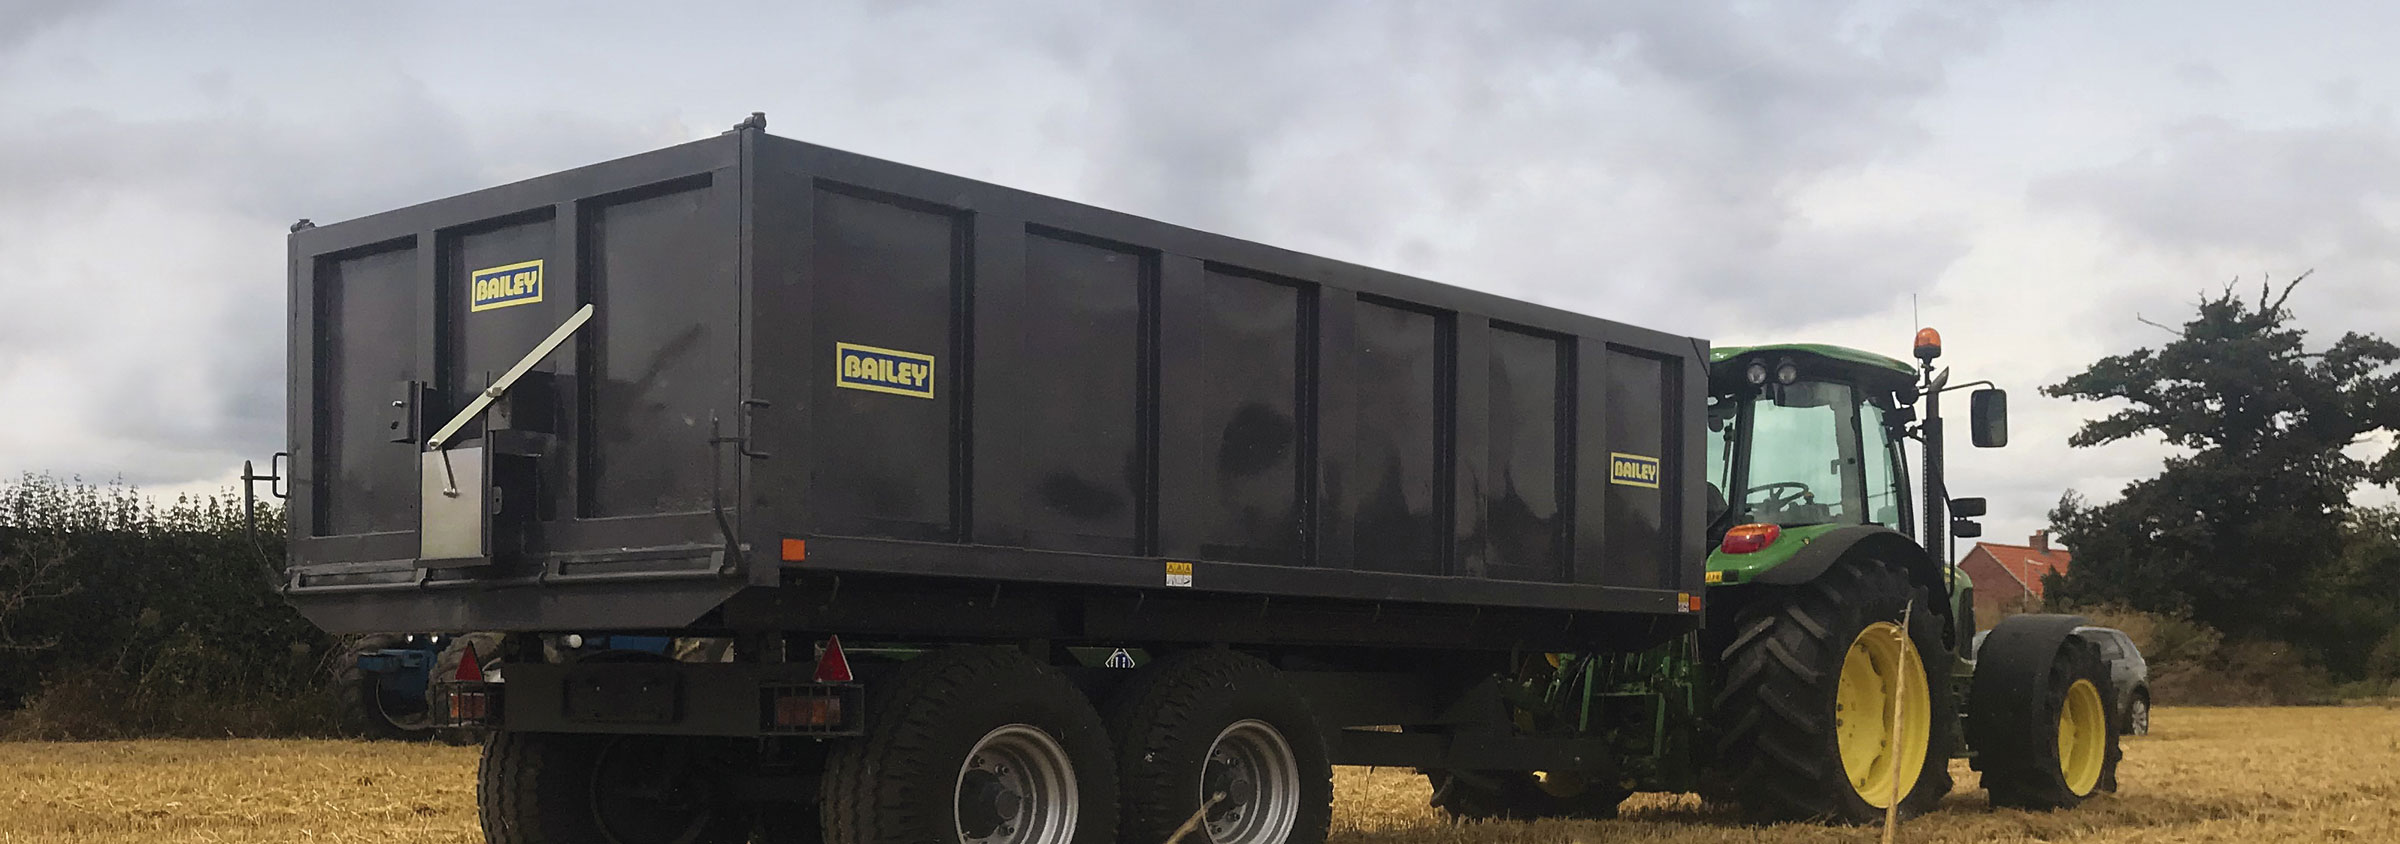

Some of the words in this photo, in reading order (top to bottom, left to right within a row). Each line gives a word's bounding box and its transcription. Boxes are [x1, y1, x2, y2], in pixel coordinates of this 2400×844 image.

[476, 270, 537, 301] BAILEY
[844, 355, 928, 386] BAILEY
[1615, 460, 1656, 480] BAILEY
